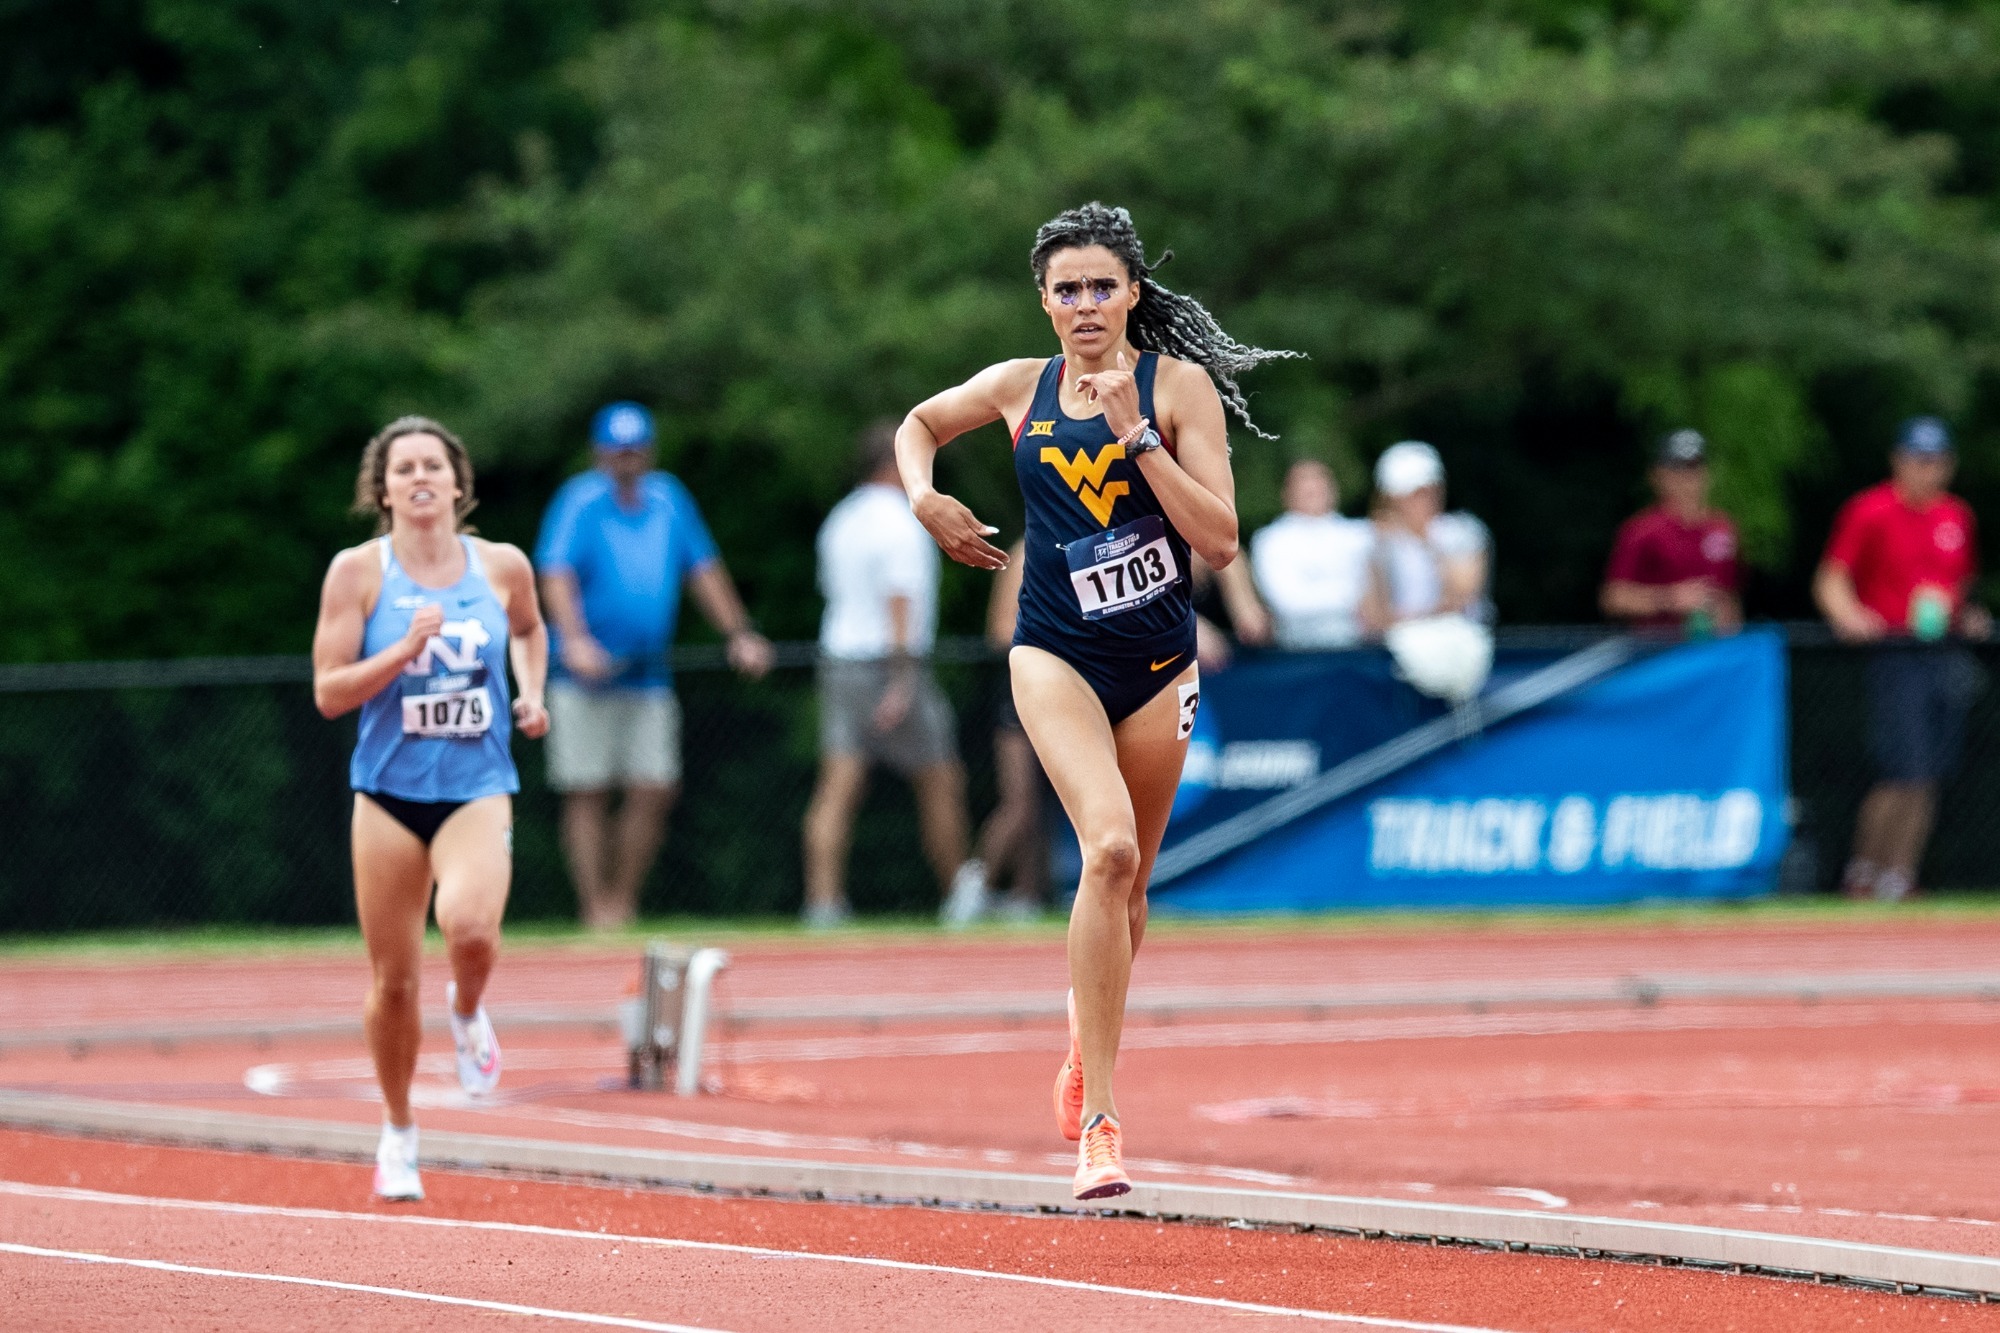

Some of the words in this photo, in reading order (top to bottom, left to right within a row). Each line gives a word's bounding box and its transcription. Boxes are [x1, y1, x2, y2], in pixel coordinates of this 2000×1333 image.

[1027, 420, 1056, 437] XII
[1108, 540, 1125, 551] TRACK
[1087, 548, 1167, 603] 1703
[417, 697, 484, 727] 1079
[1181, 692, 1200, 733] 3
[1368, 797, 1544, 874] TRACK
[1549, 794, 1595, 874] &
[1602, 788, 1763, 872] FIELD
